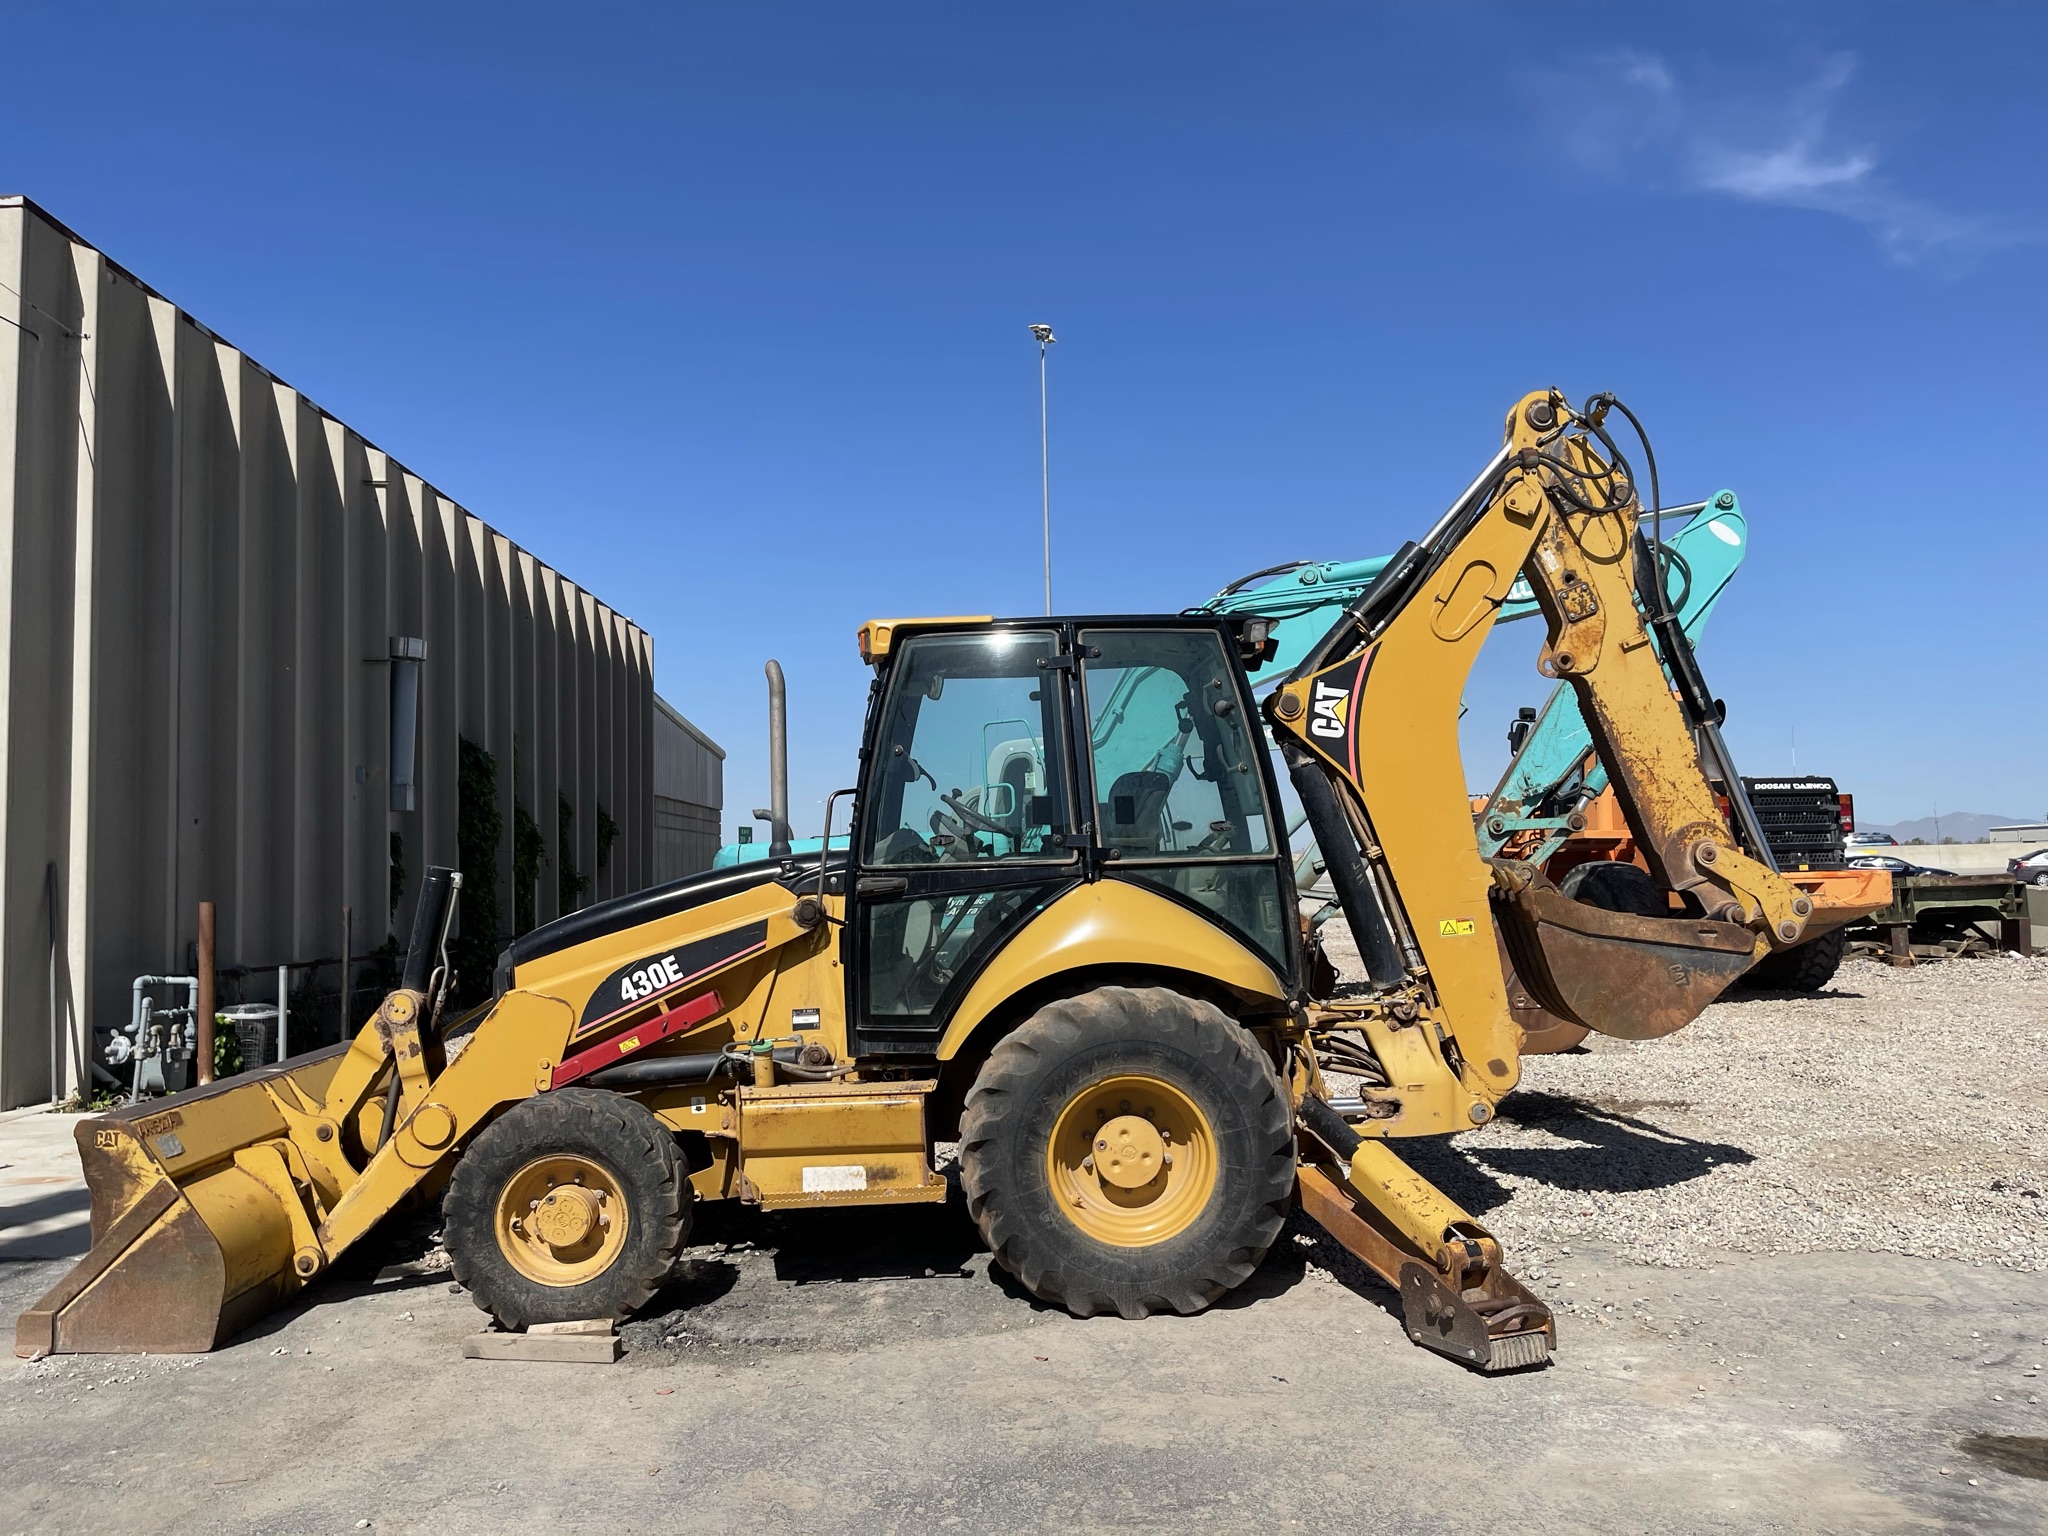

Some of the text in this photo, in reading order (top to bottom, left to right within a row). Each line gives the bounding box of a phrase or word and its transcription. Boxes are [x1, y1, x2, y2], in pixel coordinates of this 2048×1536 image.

[1311, 680, 1350, 739] CAT
[621, 954, 684, 1001] 430E
[94, 1130, 121, 1149] CAT
